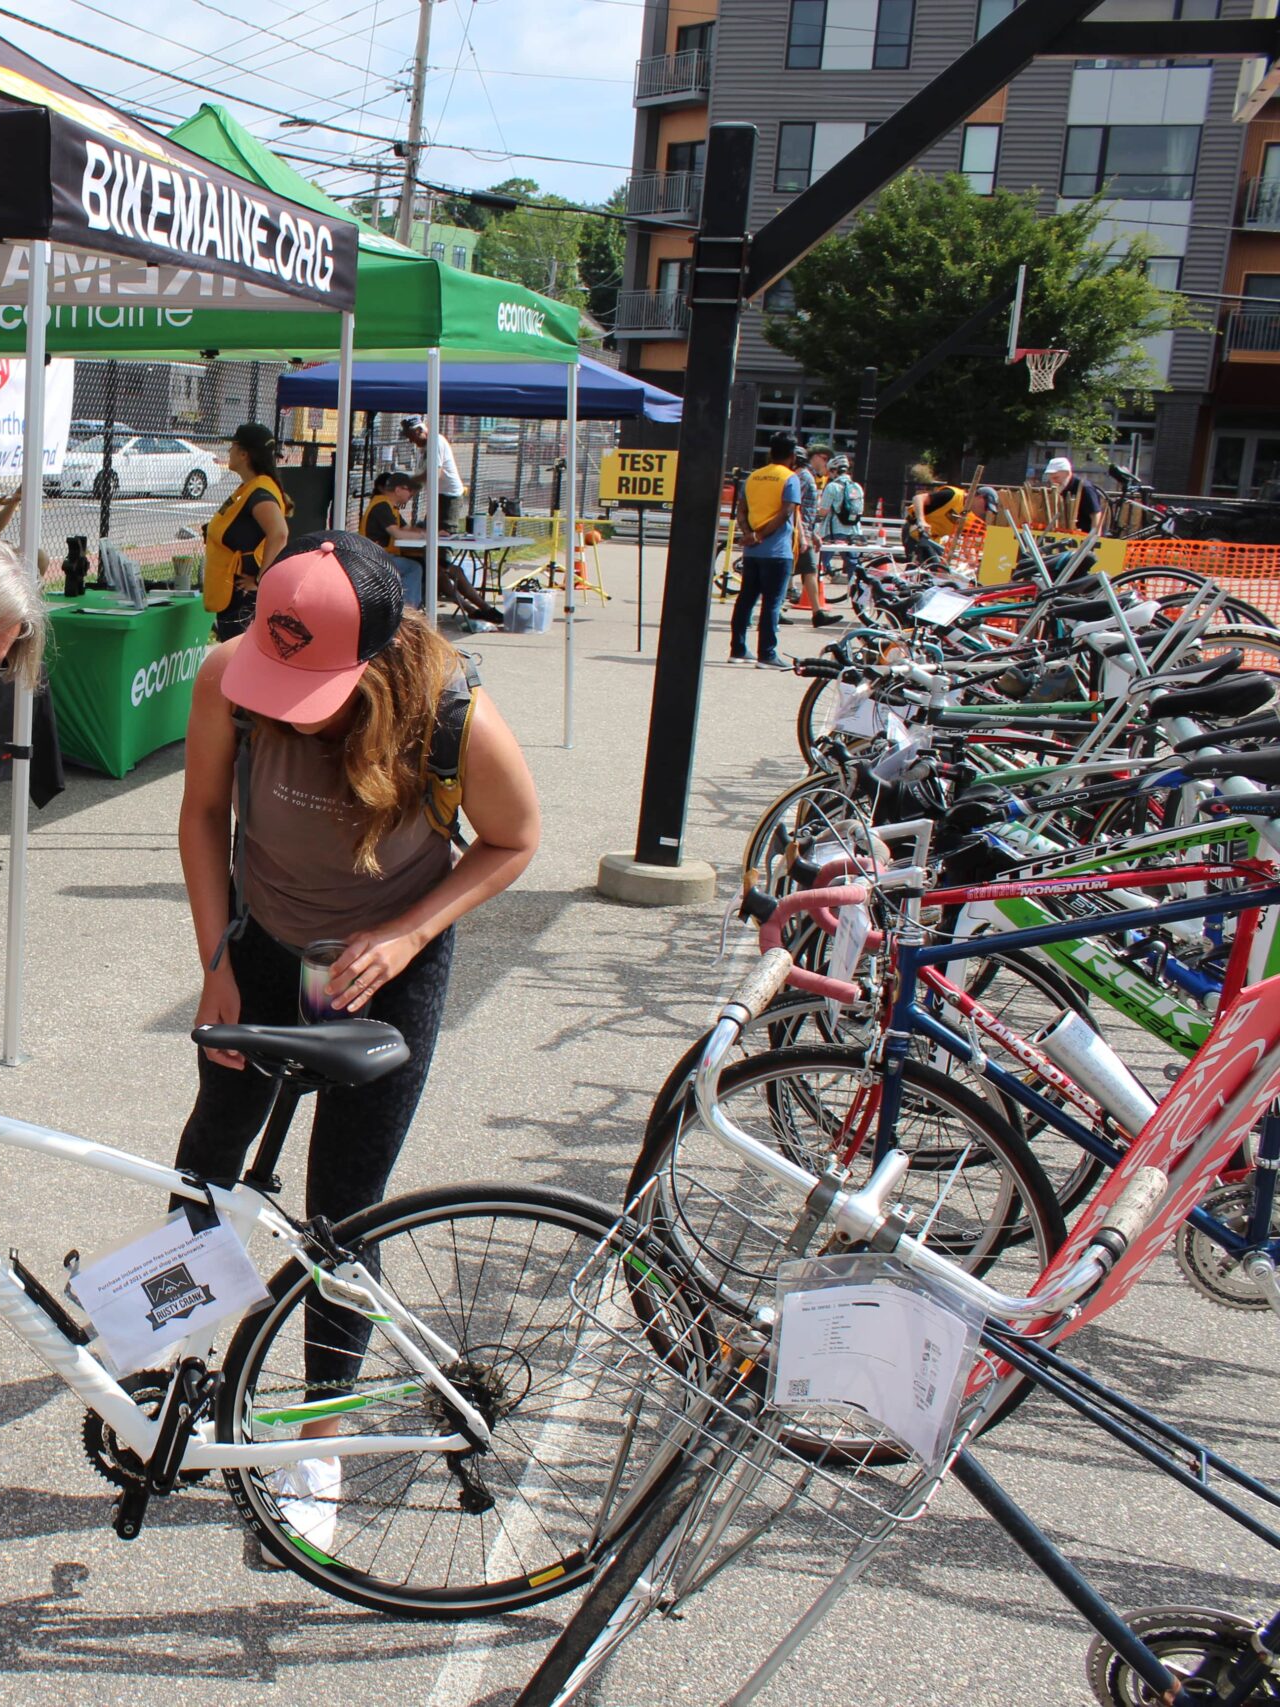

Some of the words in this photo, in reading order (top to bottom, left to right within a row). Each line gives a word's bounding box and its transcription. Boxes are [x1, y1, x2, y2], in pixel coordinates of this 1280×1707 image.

[82, 140, 335, 292] BIKEMAINE.ORG
[498, 302, 545, 337] ecomaine
[618, 453, 667, 473] TEST
[617, 476, 664, 495] RIDE
[1037, 792, 1089, 808] 2200
[1020, 880, 1109, 896] MOMENTUM
[1071, 943, 1208, 1037] TREK
[970, 1007, 1064, 1084] DIAMOND
[1120, 998, 1262, 1179] BIKES
[155, 1303, 179, 1321] RUSTY
[179, 1291, 205, 1309] CRANK
[225, 1466, 262, 1532] SERF
